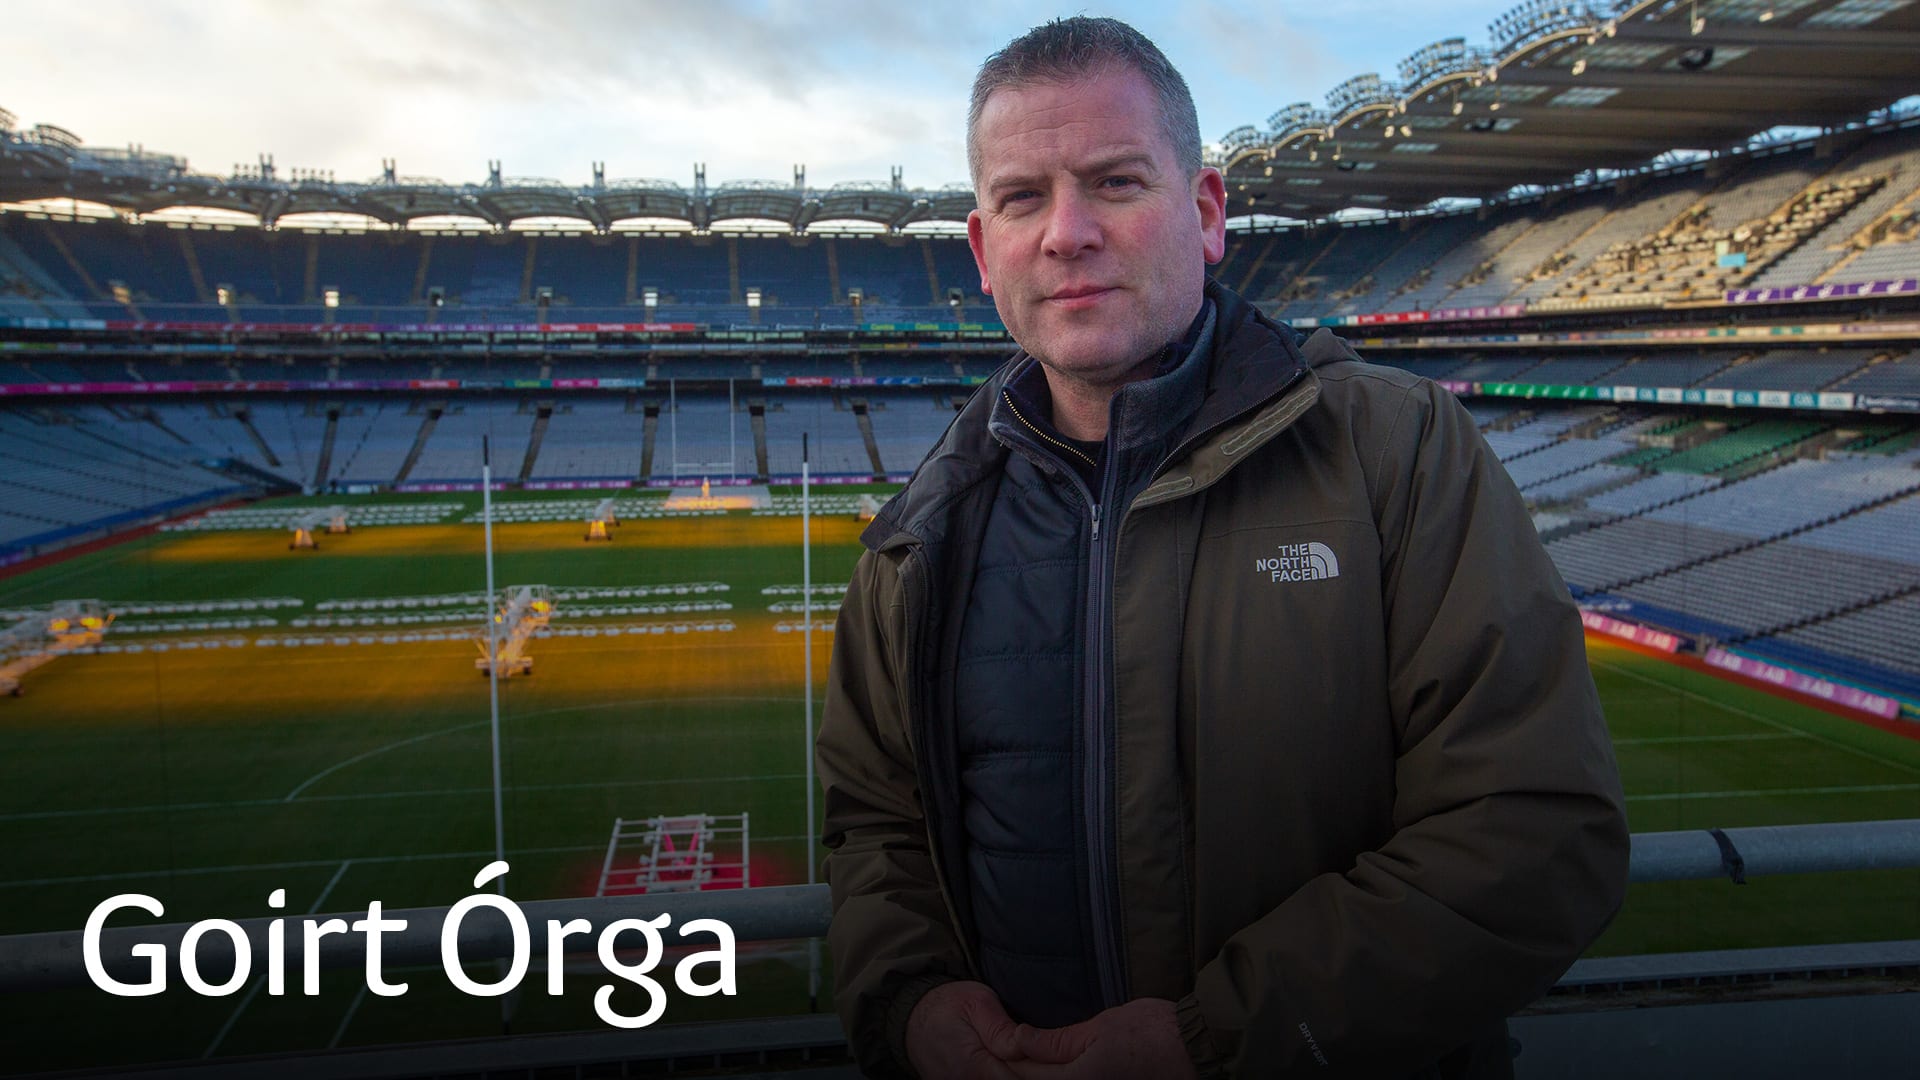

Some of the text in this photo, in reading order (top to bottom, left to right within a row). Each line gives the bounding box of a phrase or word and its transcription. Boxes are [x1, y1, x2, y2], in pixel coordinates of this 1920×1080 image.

[1278, 543, 1309, 556] THE
[1256, 556, 1309, 571] NORTH
[1271, 568, 1311, 583] FACE
